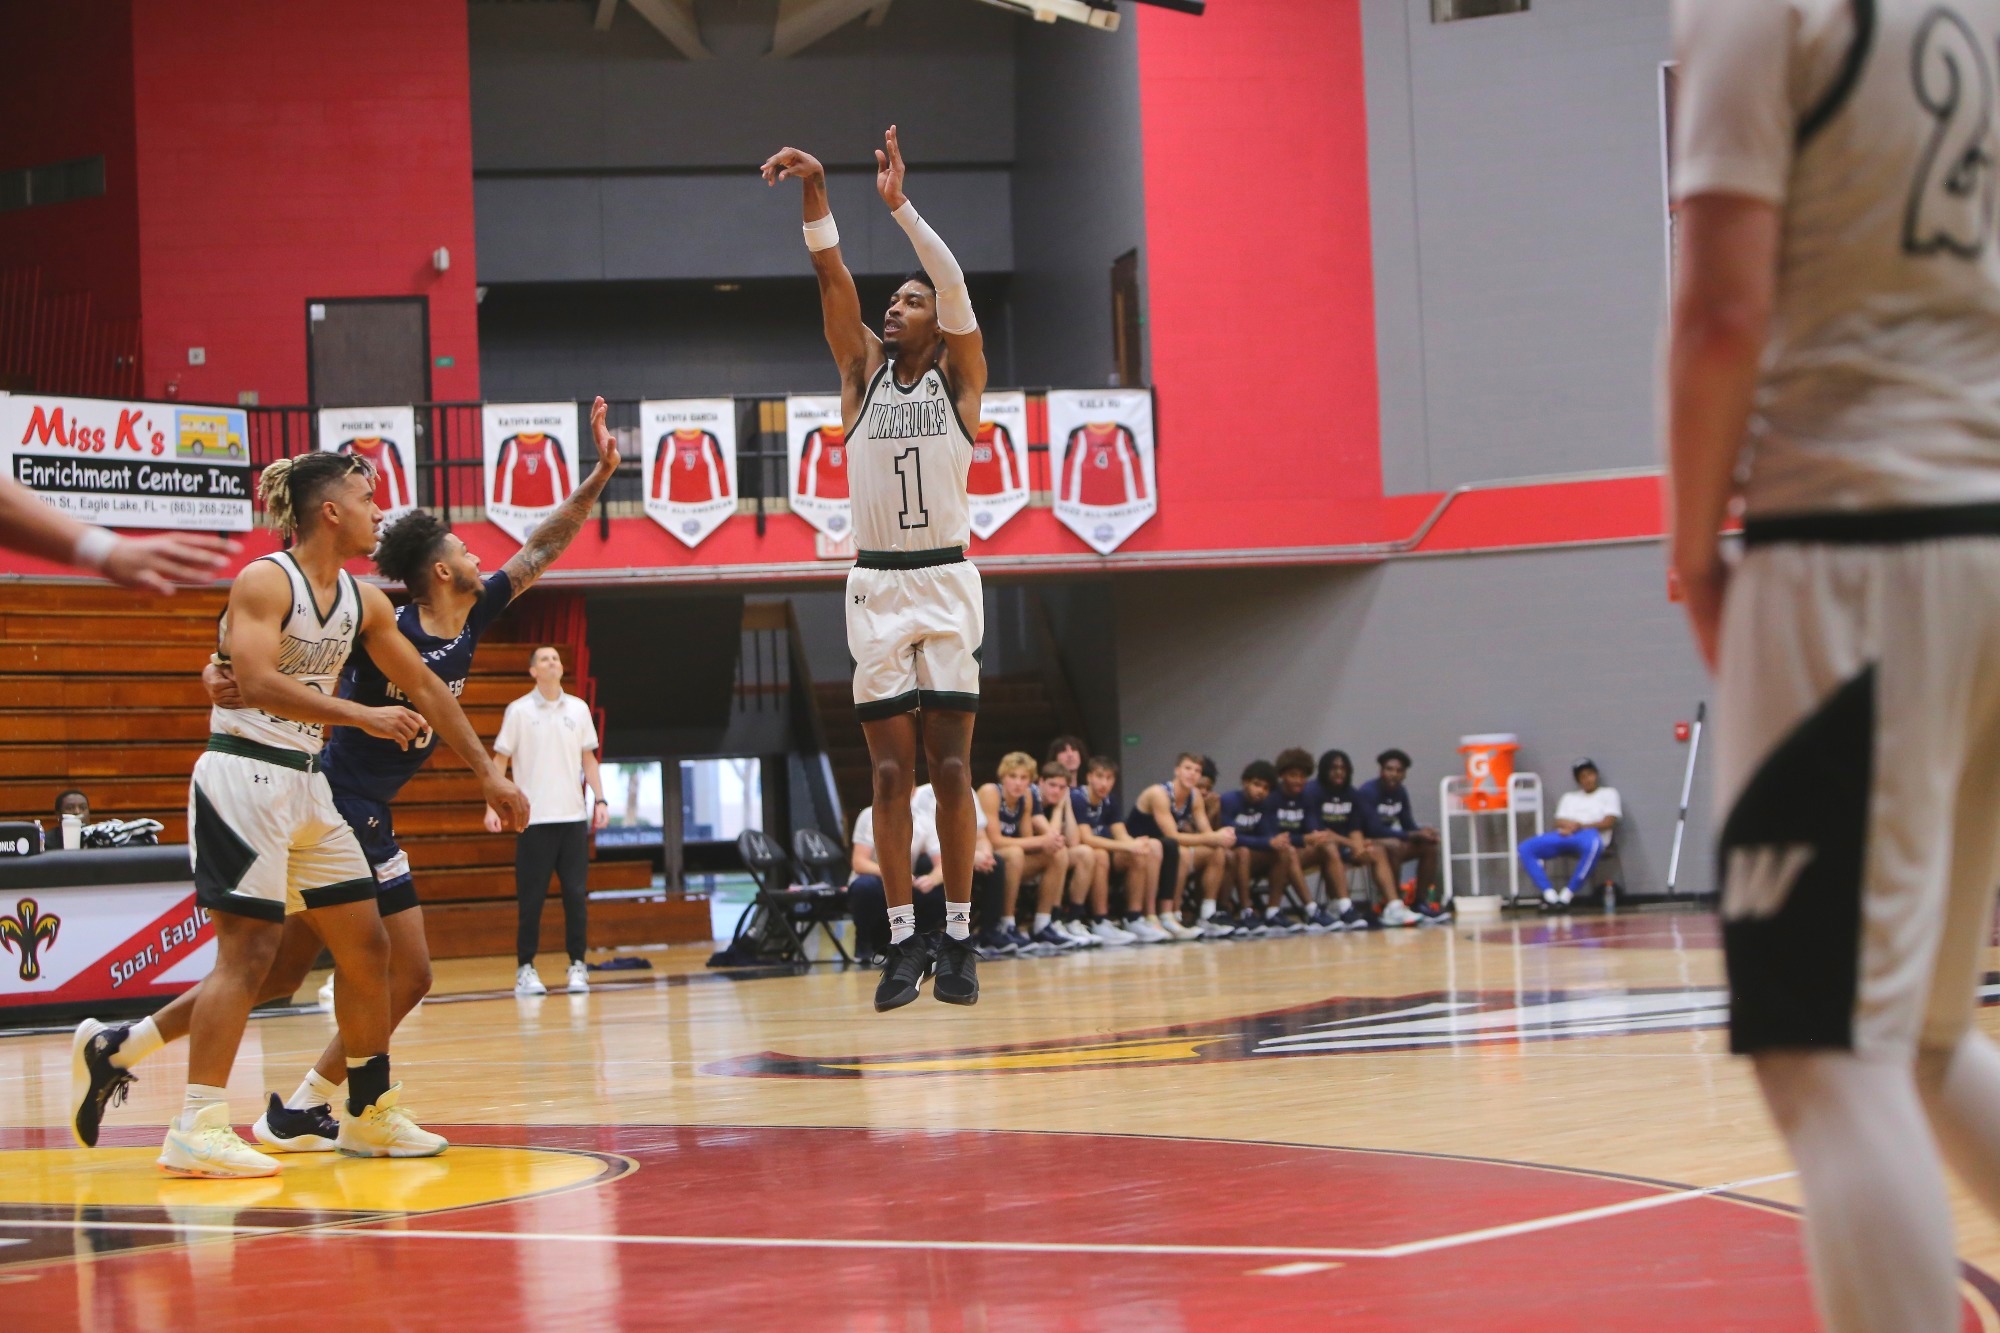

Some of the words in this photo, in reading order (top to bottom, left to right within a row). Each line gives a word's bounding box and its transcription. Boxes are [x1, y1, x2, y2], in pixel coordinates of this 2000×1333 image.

[21, 405, 105, 453] Miss
[114, 408, 166, 457] K's
[341, 421, 374, 431] PHOEBE
[868, 398, 948, 440] WARRIORS
[1095, 451, 1109, 469] 4
[18, 457, 132, 491] Enrichment
[136, 465, 204, 493] Center
[208, 468, 246, 496] Inc.
[894, 446, 928, 530] 1
[80, 496, 110, 514] Eagle
[113, 498, 141, 513] Lake,
[144, 500, 158, 513] FL
[170, 501, 196, 516] (863)
[199, 502, 244, 516] 268-2254
[1469, 753, 1490, 778] G
[0, 840, 16, 853] NUS
[110, 943, 160, 989] Soar,
